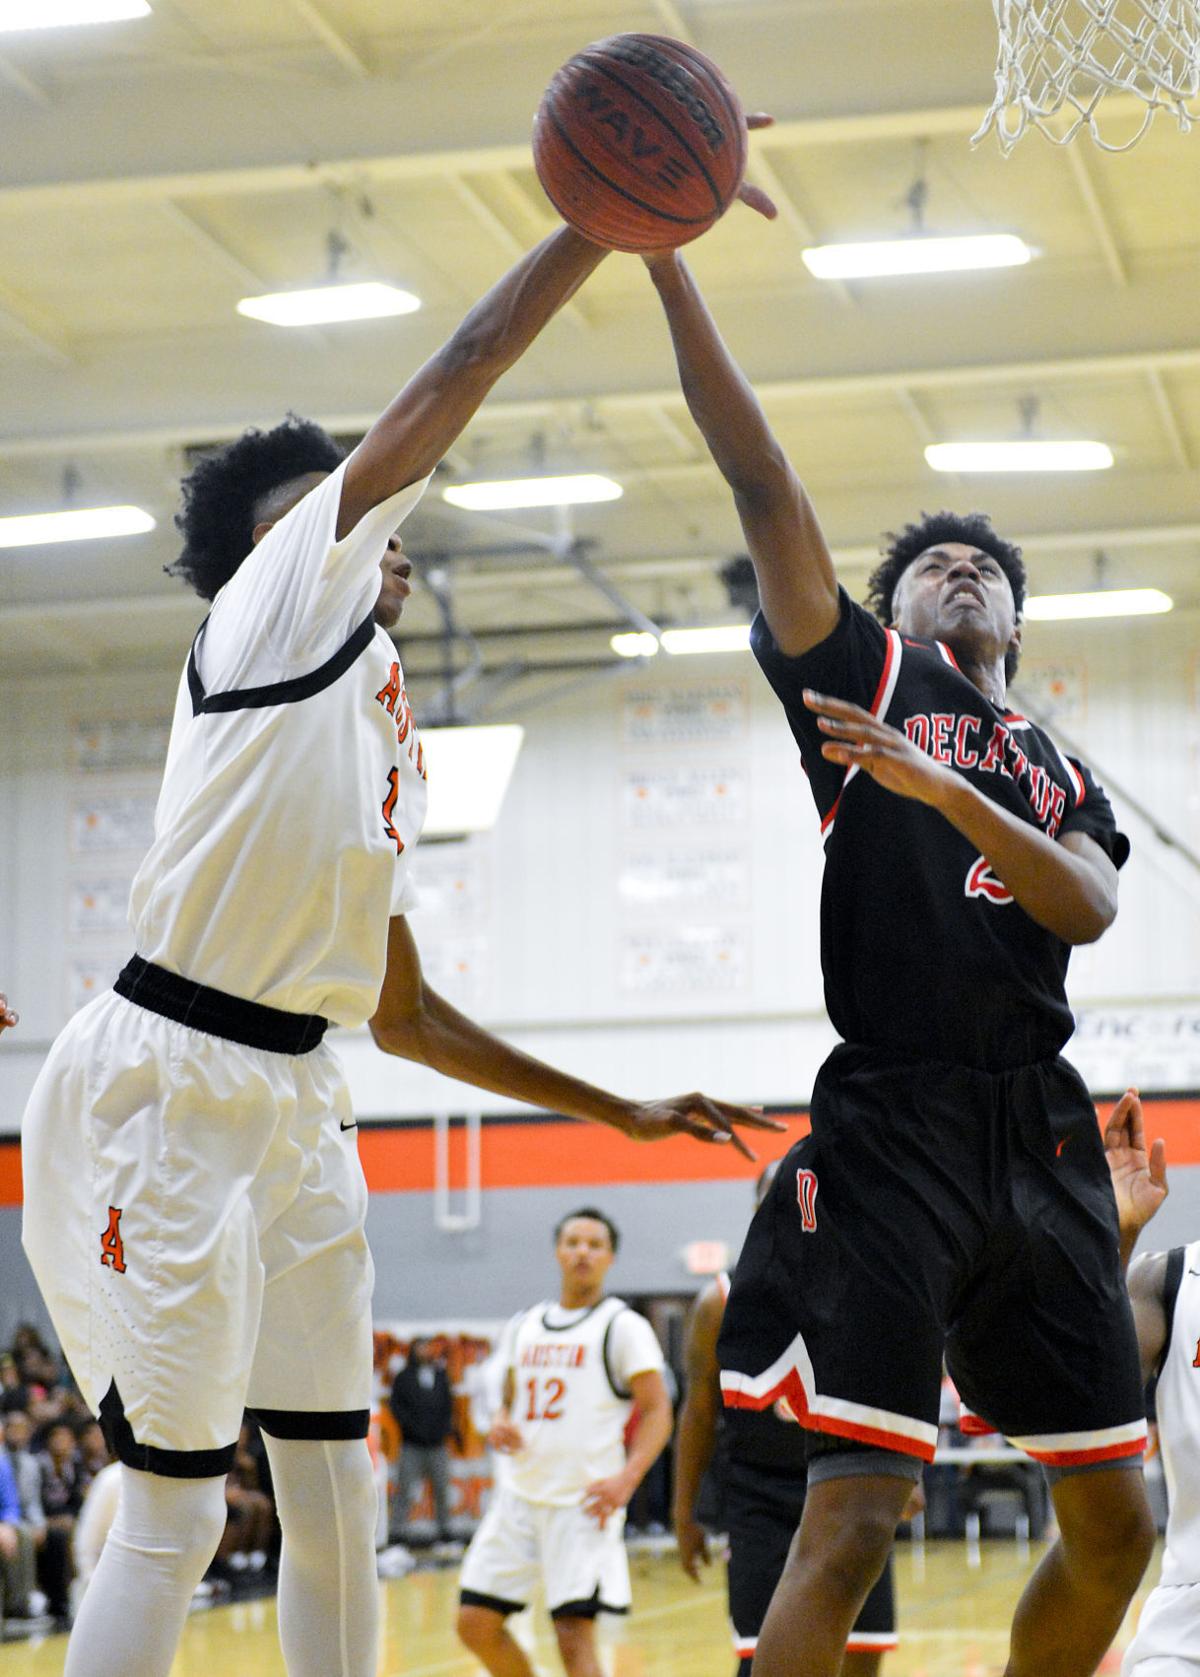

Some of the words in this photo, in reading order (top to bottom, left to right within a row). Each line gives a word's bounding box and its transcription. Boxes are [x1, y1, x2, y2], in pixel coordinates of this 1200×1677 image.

[573, 74, 697, 191] WAVE
[904, 712, 1067, 840] DECATUR
[796, 1167, 819, 1233] D
[100, 1205, 127, 1274] A
[521, 1343, 585, 1368] AUSTIN
[525, 1377, 566, 1421] 12
